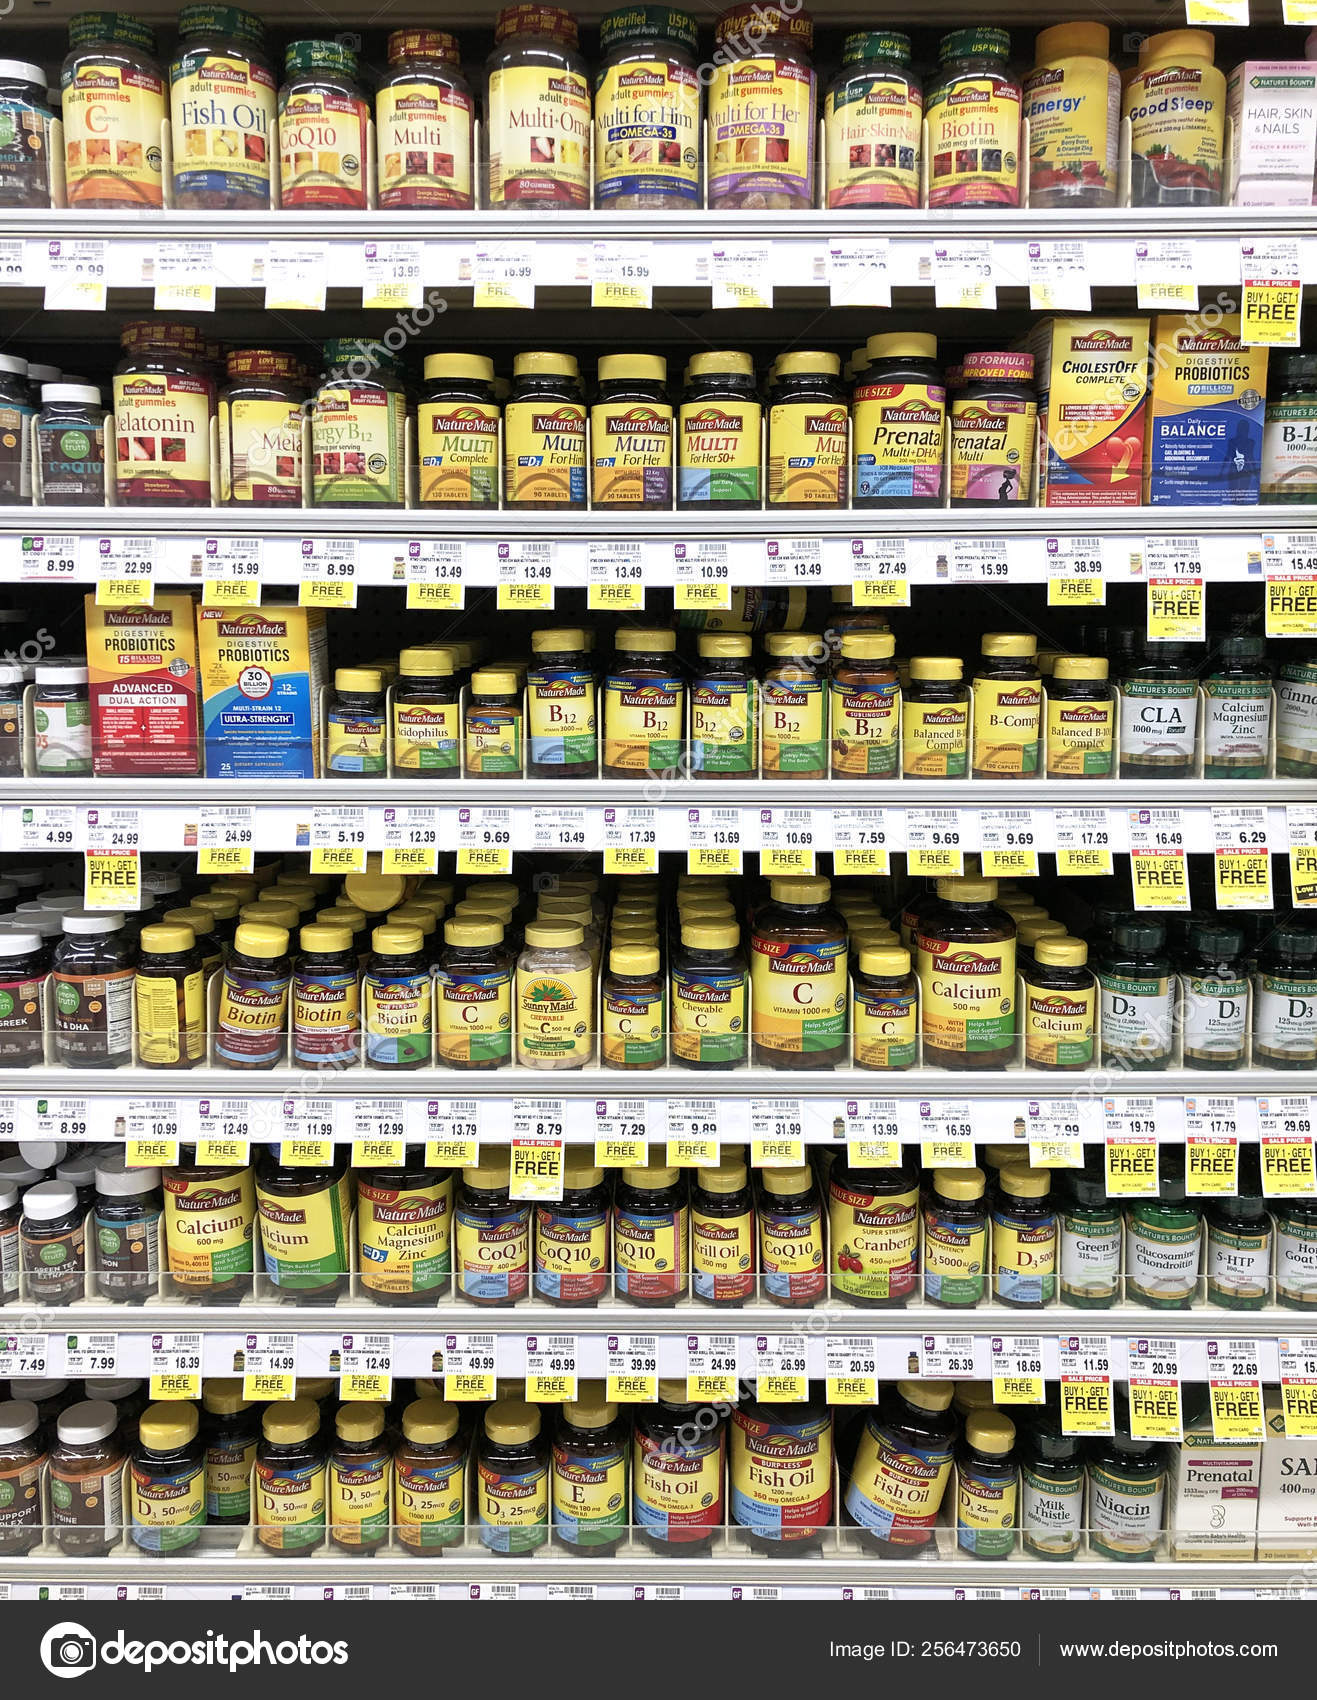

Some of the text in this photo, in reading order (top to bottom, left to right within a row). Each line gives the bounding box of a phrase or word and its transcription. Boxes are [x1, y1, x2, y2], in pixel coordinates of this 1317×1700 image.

[191, 83, 256, 98] adult gummies
[633, 89, 674, 99] gummies
[721, 86, 782, 99] adult gummies
[86, 93, 130, 103] gummies
[743, 104, 769, 121] for
[773, 103, 800, 122] Her
[939, 106, 998, 119] adult gummies
[1130, 98, 1212, 121] Good Sleep
[1248, 108, 1312, 119] HAIR, SKIN
[86, 106, 108, 132] C
[182, 101, 266, 133] Fish Oil
[389, 113, 446, 123] adult gummies
[633, 104, 659, 123] for
[662, 107, 692, 128] Him
[942, 118, 994, 139] Biotin
[1263, 124, 1299, 134] NAILS
[394, 129, 441, 145] Multi
[1247, 292, 1263, 303] BUY
[1276, 292, 1293, 302] GET
[1247, 305, 1295, 320] FREE
[980, 355, 1025, 366] FORMULA
[1175, 366, 1249, 380] PROBIOTICS
[1076, 376, 1125, 384] COMPLETE
[871, 388, 892, 396] SIZE
[1189, 385, 1200, 394] 10
[135, 398, 176, 407] gummies
[1161, 425, 1226, 436] BALANCE
[450, 453, 488, 464] Complete
[551, 454, 568, 464] For
[623, 454, 660, 465] For Her
[690, 453, 735, 463] For Her 50+
[958, 451, 984, 461] Multi
[125, 562, 151, 574] 22.99
[232, 563, 258, 574] 15.99
[701, 566, 728, 578] 10.99
[794, 564, 821, 575] 13.49
[981, 564, 1008, 575] 15.99
[1074, 561, 1101, 572] 38.99
[435, 567, 462, 578] 13.49
[525, 567, 551, 578] 13.49
[109, 584, 140, 594] FREE
[216, 585, 247, 595] FREE
[420, 588, 450, 598] FREE
[687, 588, 717, 598] FREE
[1061, 583, 1092, 593] FREE
[1153, 601, 1200, 615] FREE
[105, 639, 175, 651] PROBIOTICS
[119, 655, 130, 664] 15
[218, 649, 290, 662] PROBIOTICS
[248, 672, 262, 681] 30
[113, 684, 173, 693] ADVANCED
[1132, 684, 1193, 695] NATURE'S BOUNTY
[109, 696, 176, 704] DUAL ACTION
[1222, 703, 1264, 713] Calcium
[1140, 706, 1182, 723] CLA
[913, 729, 954, 739] Balanced
[1051, 727, 1093, 737] Balanced
[1133, 725, 1162, 735] 1000 mg
[1232, 725, 1255, 735] Zinc
[46, 831, 73, 843] 4.99
[112, 833, 138, 844] 24.99
[338, 831, 364, 842] 5.19
[410, 831, 435, 842] 12.39
[559, 832, 585, 843] 13.49
[630, 832, 655, 843] 17.39
[786, 832, 812, 844] 10.69
[858, 832, 885, 844] 7.59
[1081, 832, 1108, 844] 17.29
[1155, 832, 1182, 844] 16.49
[211, 852, 240, 862] FREE
[395, 853, 424, 862] FREE
[700, 854, 729, 863] FREE
[995, 855, 1025, 864] FREE
[91, 871, 136, 885] FREE
[1137, 871, 1183, 885] FREE
[793, 982, 813, 1004] C
[932, 981, 1001, 999] Calcium
[682, 1002, 723, 1013] Chewable
[802, 1006, 820, 1014] 1000
[228, 1007, 276, 1024] Biotin
[378, 1012, 418, 1025] Biotin
[462, 1006, 479, 1023] C
[1032, 1016, 1082, 1030] Calcium
[61, 1122, 86, 1134] 8.99
[152, 1123, 177, 1135] 10.99
[307, 1124, 332, 1135] 11.99
[378, 1124, 403, 1135] 12.99
[536, 1124, 562, 1135] 8.79
[620, 1124, 645, 1135] 7.29
[946, 1124, 971, 1136] 16.59
[1130, 1121, 1155, 1133] 19.79
[1284, 1120, 1310, 1132] 29.69
[138, 1146, 166, 1154] FREE
[515, 1161, 559, 1176] FREE
[1110, 1159, 1153, 1172] FREE
[176, 1216, 243, 1235] Calcium
[386, 1223, 436, 1236] Calcium
[197, 1238, 211, 1246] 600
[378, 1231, 444, 1247] Magnesium
[399, 1249, 427, 1261] Zinc
[1216, 1251, 1254, 1267] 5-HTP
[20, 1359, 45, 1371] 7.49
[175, 1357, 199, 1369] 18.39
[269, 1357, 293, 1369] 14.99
[469, 1357, 494, 1369] 49.99
[550, 1359, 574, 1370] 49.99
[711, 1358, 736, 1370] 24.99
[850, 1360, 874, 1372] 20.59
[1016, 1360, 1041, 1372] 18.69
[1084, 1359, 1108, 1370] 11.59
[1232, 1363, 1257, 1375] 22.69
[161, 1379, 189, 1388] FREE
[1065, 1397, 1108, 1411] FREE
[750, 1467, 814, 1488] Fish Oil
[1187, 1470, 1253, 1483] Prenatal
[873, 1474, 929, 1504] Fish Oil
[1040, 1498, 1064, 1510] Milk
[1095, 1491, 1151, 1515] Niacin
[1034, 1504, 1070, 1520] Thistle
